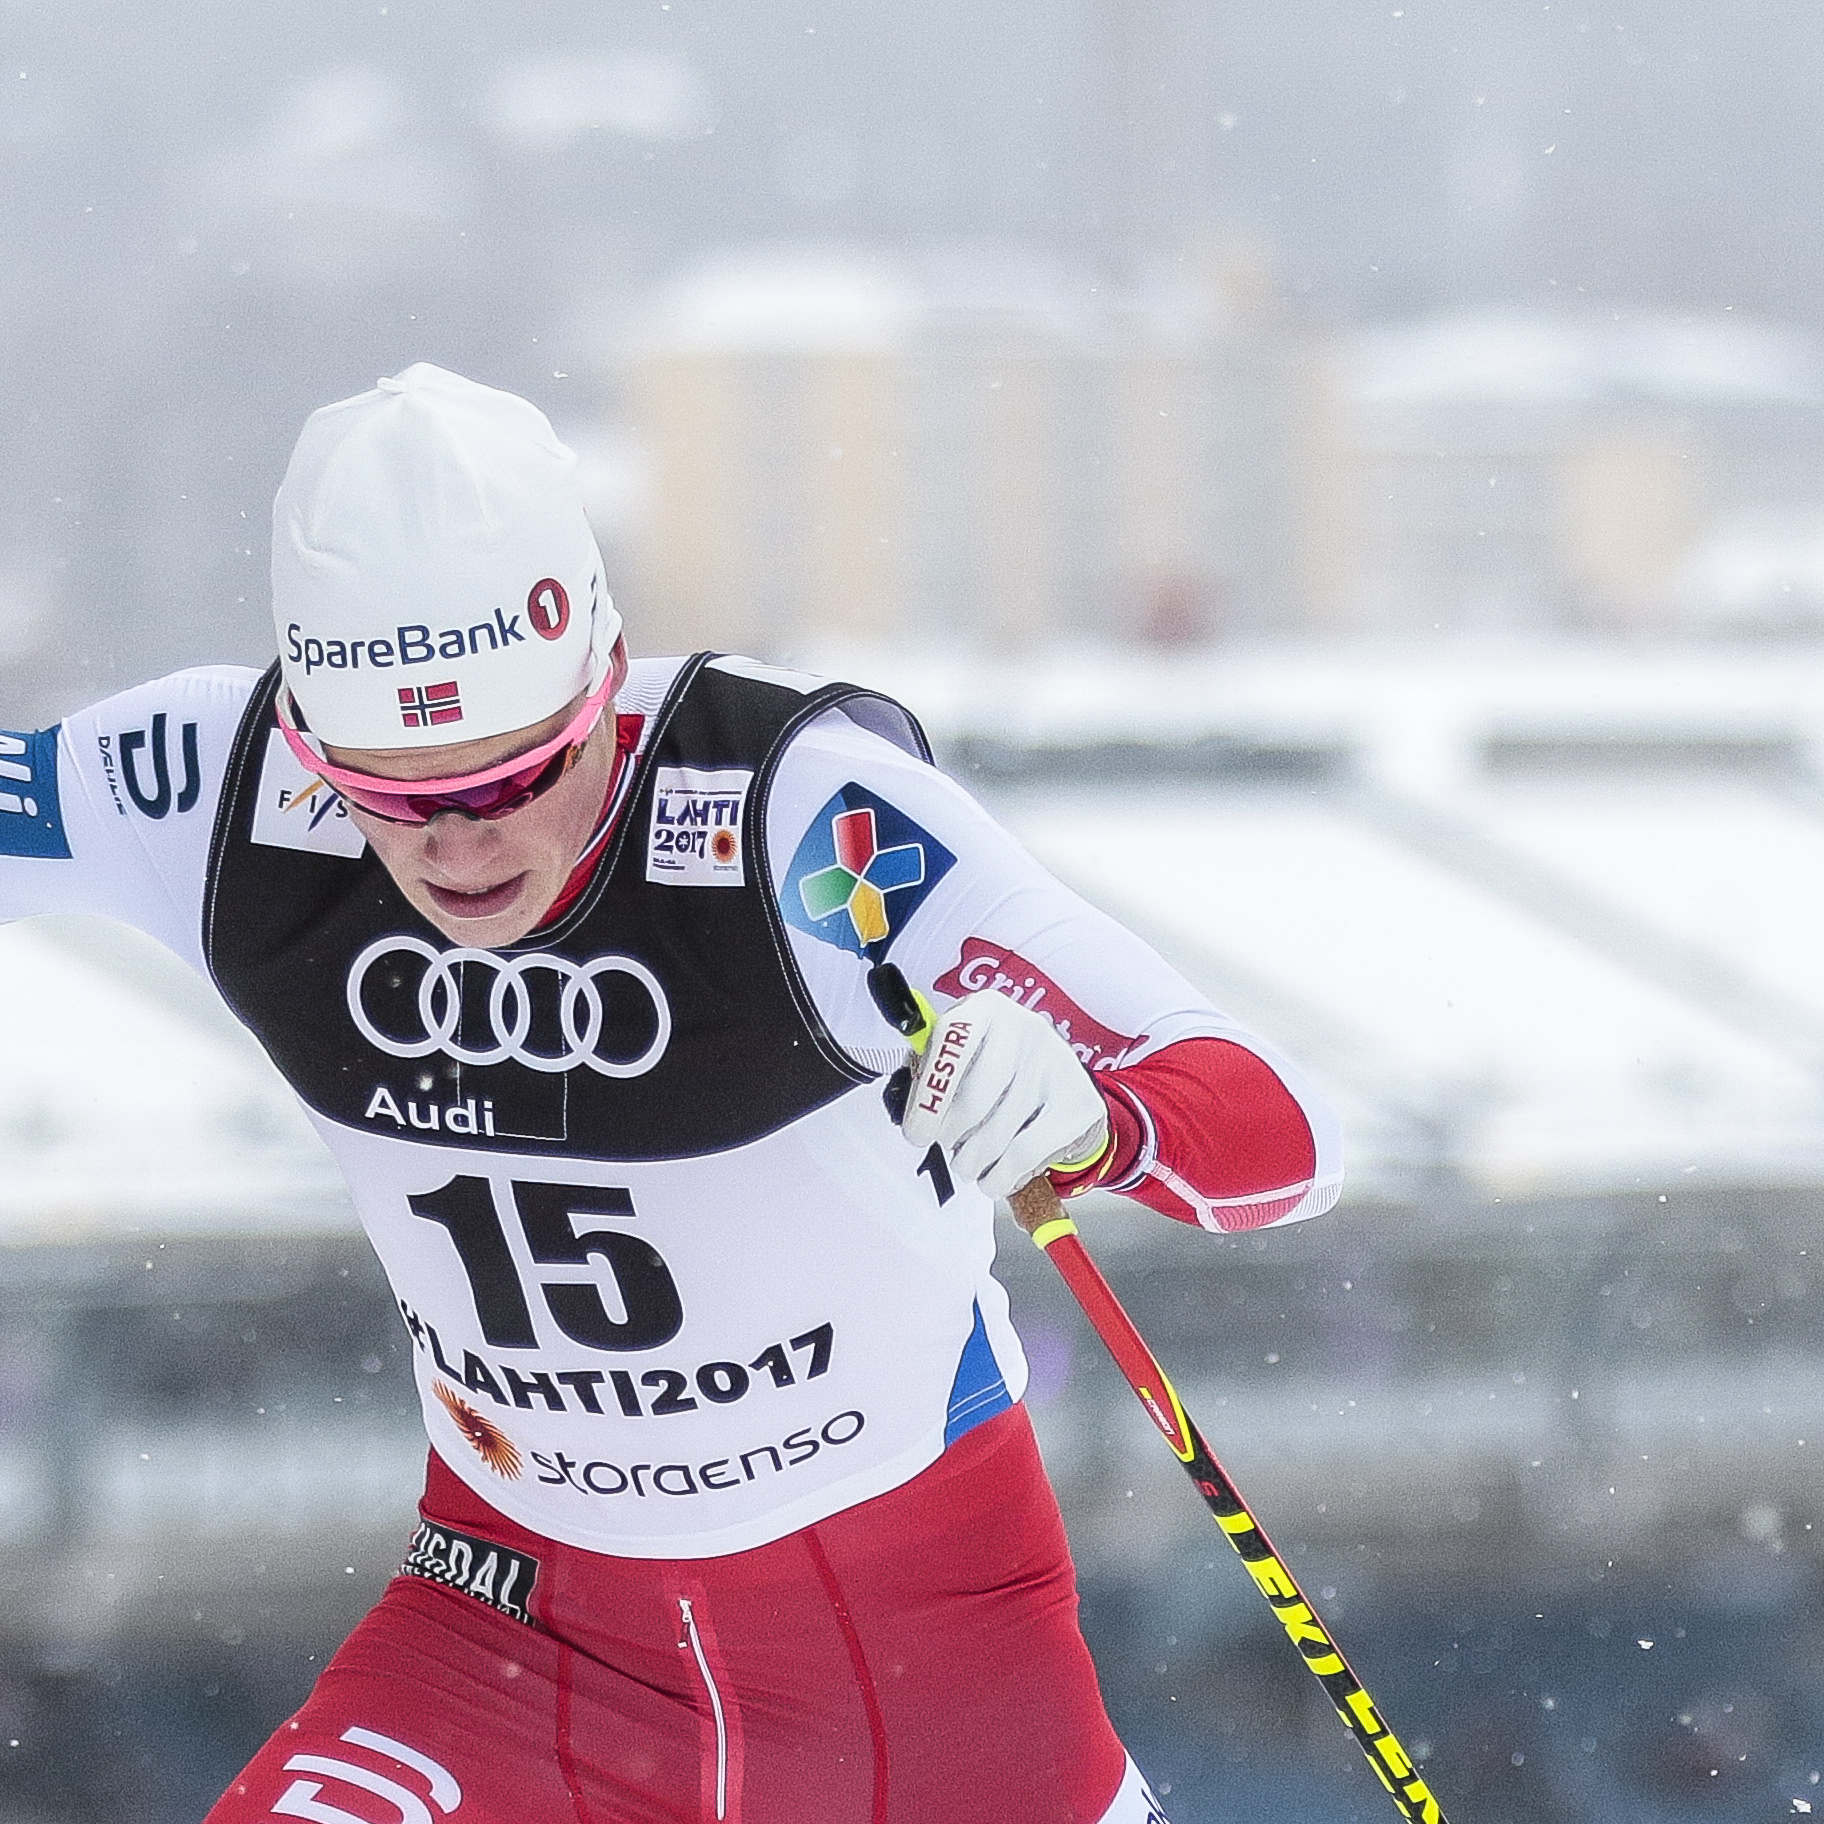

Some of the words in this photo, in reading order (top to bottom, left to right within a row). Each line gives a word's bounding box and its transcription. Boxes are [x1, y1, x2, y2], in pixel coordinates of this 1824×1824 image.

[287, 608, 526, 675] SpareBank
[278, 790, 348, 818] FIS
[656, 798, 739, 826] LAHTI
[654, 829, 708, 859] 2017
[919, 1022, 972, 1114] HESTRA
[365, 1087, 496, 1137] Audi
[407, 1174, 685, 1353] 15
[1213, 1511, 1345, 1676] LEKI
